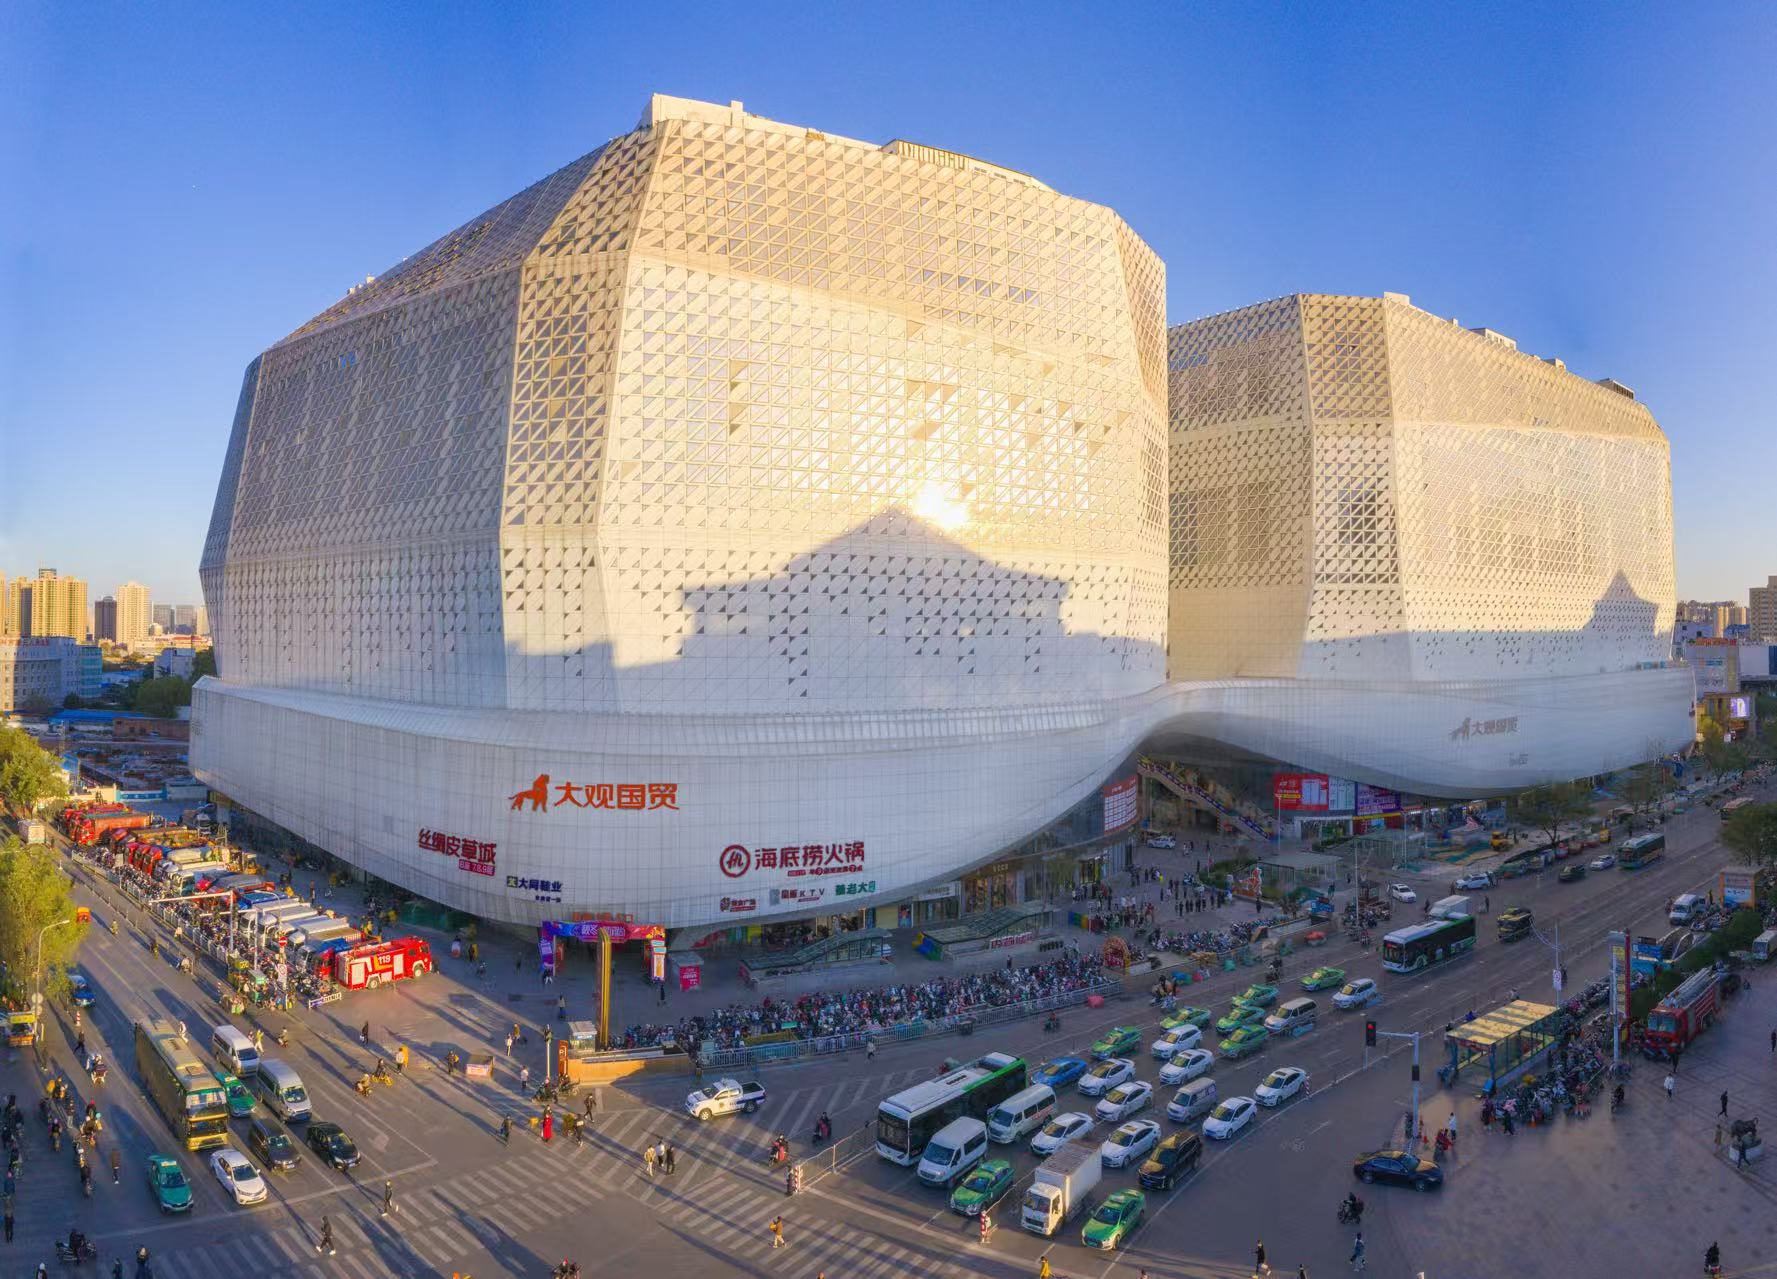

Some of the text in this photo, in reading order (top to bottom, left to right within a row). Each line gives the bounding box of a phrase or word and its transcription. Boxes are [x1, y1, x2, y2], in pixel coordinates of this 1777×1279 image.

[553, 781, 681, 811] 大观国贸
[755, 841, 865, 871] 海底捞火锅
